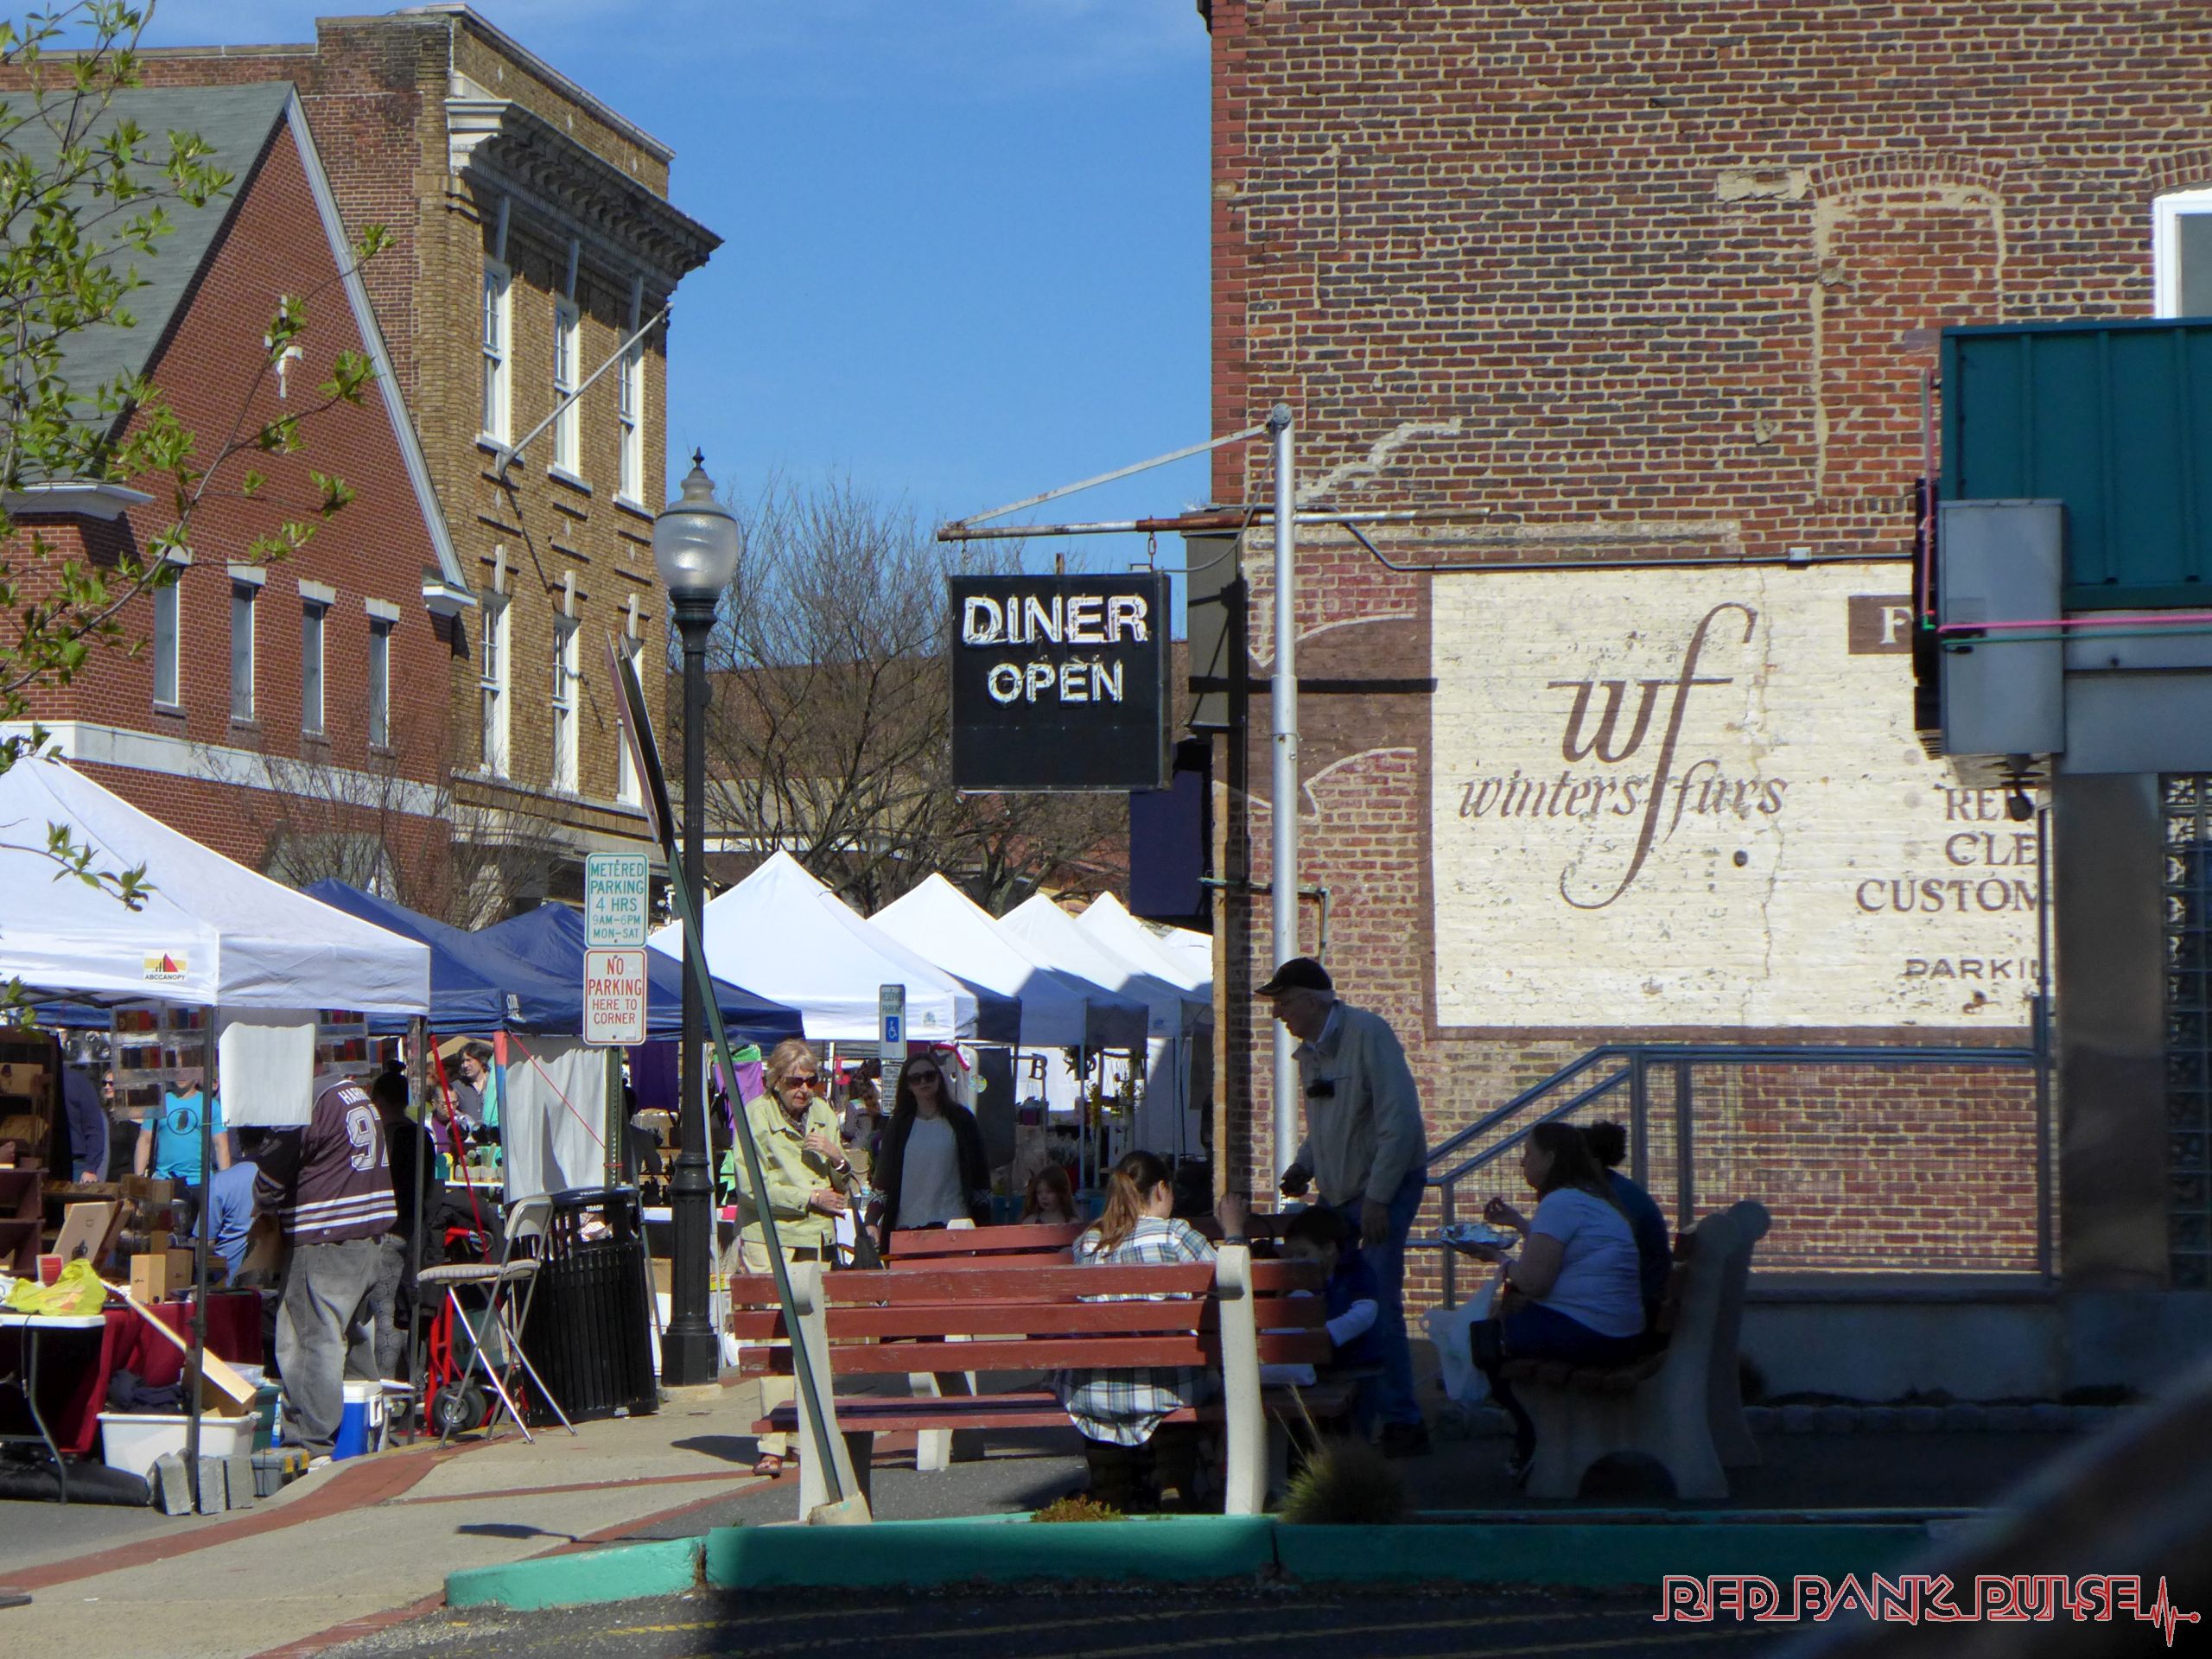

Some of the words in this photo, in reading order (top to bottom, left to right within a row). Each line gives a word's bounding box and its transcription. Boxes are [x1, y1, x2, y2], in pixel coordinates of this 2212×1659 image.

[963, 594, 1148, 645] DINER
[988, 659, 1123, 703] OPEN
[1459, 766, 1637, 818] winters
[1662, 760, 1788, 844] furs
[591, 863, 644, 877] METERED
[591, 880, 644, 895] PARKING
[595, 898, 605, 912] 4
[611, 898, 638, 912] HRS
[593, 915, 640, 925] 9AM-6PM
[593, 928, 639, 939] MON-SAT
[607, 958, 625, 976] NO
[588, 979, 642, 996] PARKING
[592, 999, 620, 1011] HERE
[626, 999, 637, 1011] TO
[594, 1012, 636, 1025] CORNER
